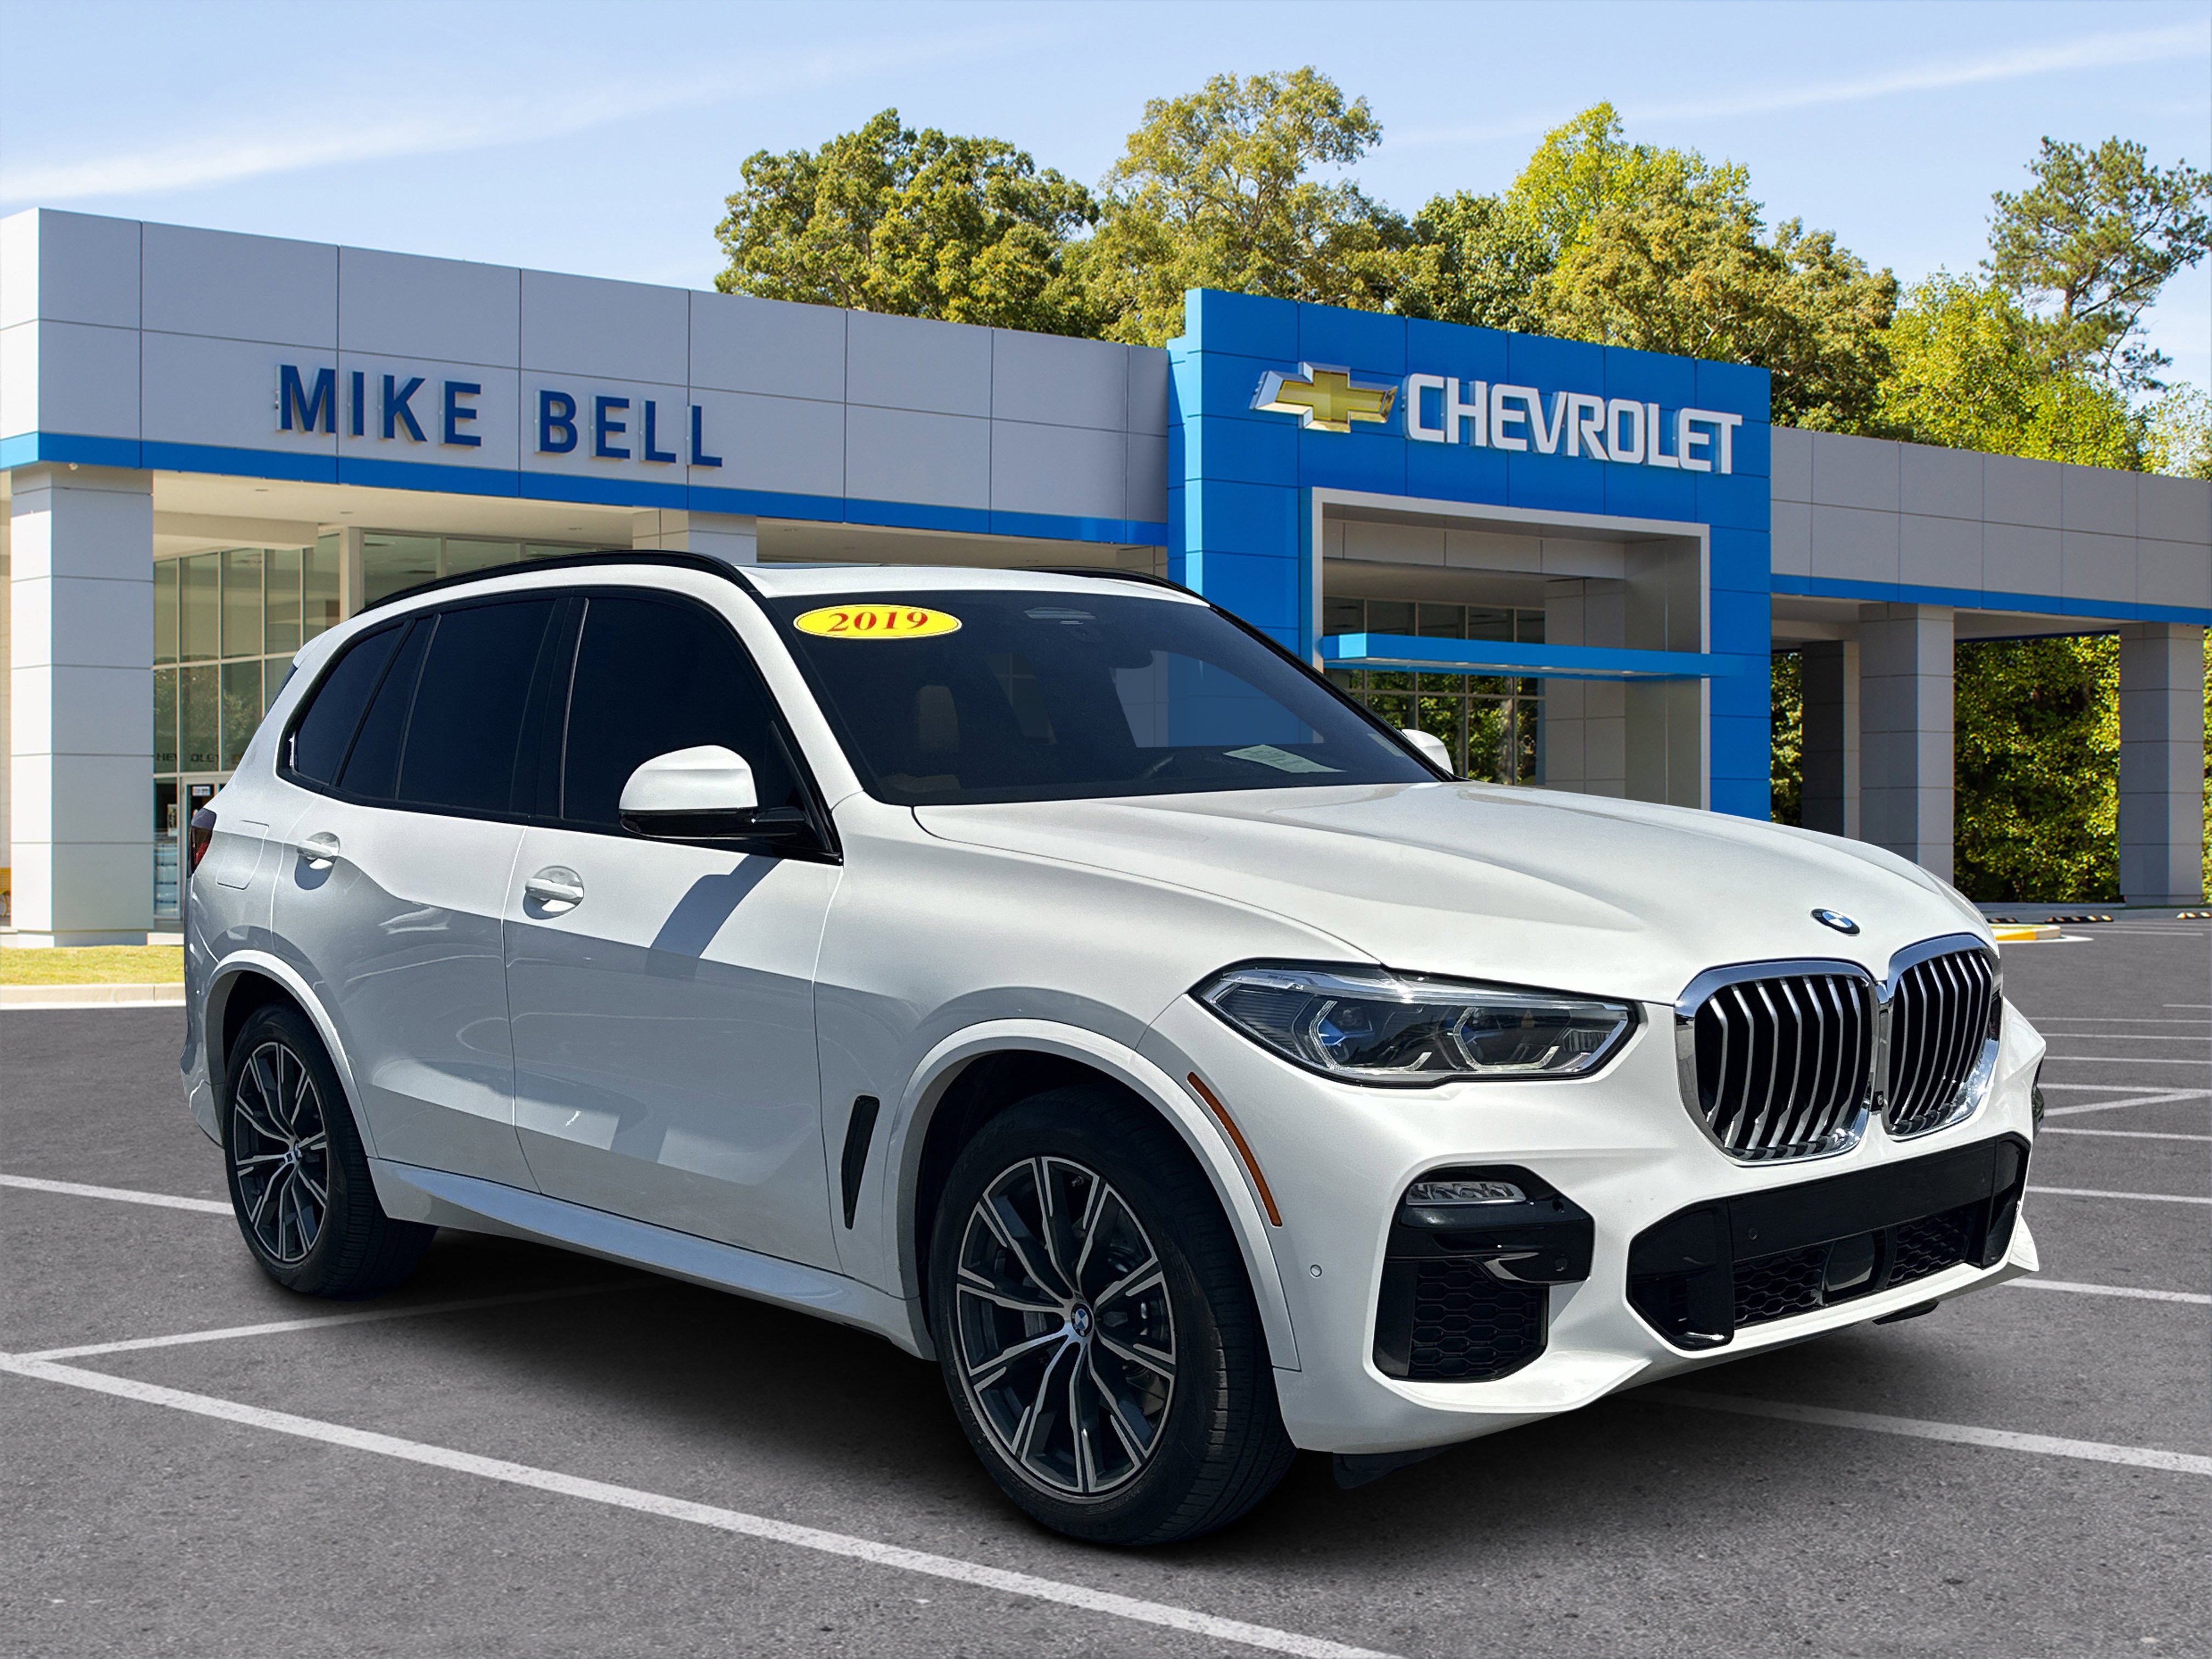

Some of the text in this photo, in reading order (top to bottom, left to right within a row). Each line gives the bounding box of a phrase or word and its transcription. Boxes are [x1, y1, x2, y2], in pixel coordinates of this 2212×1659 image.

[276, 364, 723, 467] MIKE BELL
[1403, 373, 1742, 475] CHEVROLET
[827, 611, 928, 633] 2019
